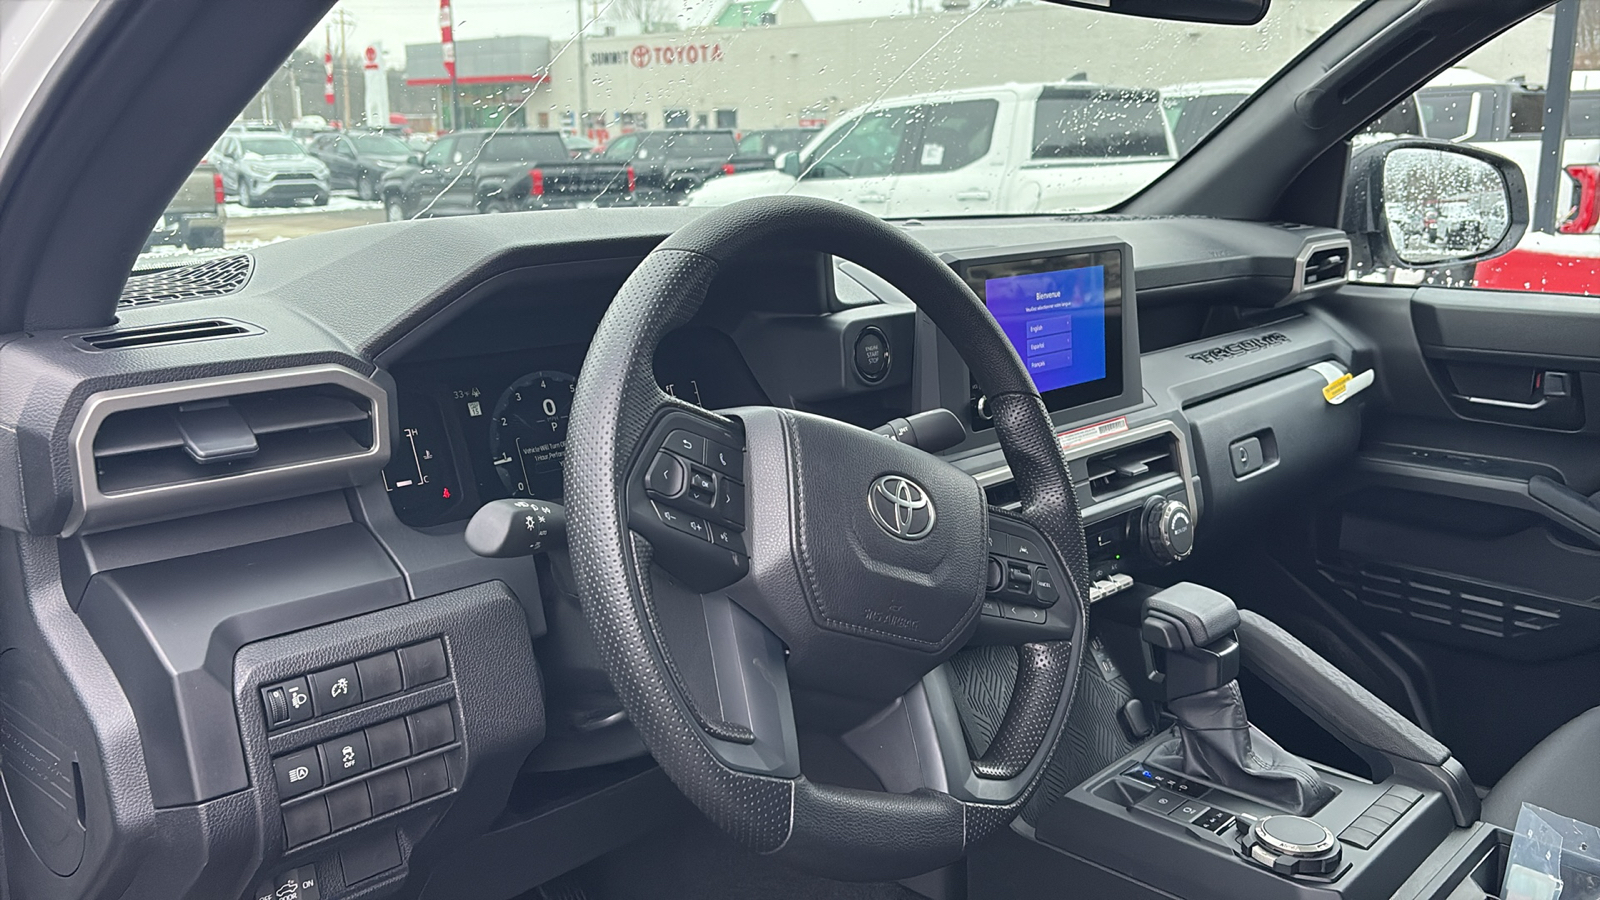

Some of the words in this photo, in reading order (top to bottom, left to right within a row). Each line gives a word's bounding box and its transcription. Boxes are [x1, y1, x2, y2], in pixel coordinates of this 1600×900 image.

[591, 50, 629, 66] SUMMIT
[653, 43, 723, 65] TOYOTA
[1035, 291, 1061, 301] Bienvenue
[1030, 324, 1043, 333] English
[1186, 331, 1292, 365] TACOMA
[866, 350, 879, 358] START
[868, 357, 879, 365] STOP
[540, 380, 547, 389] 4
[569, 384, 576, 393] 5
[515, 392, 522, 401] 3
[542, 398, 557, 416] 0
[501, 417, 508, 427] 2
[551, 422, 558, 432] P
[411, 428, 419, 436] H
[522, 446, 540, 455] Vehicle
[423, 475, 430, 484] C
[518, 482, 524, 491] 0
[1036, 580, 1052, 589] CANCEL
[884, 615, 919, 631] AIRBAG
[343, 759, 356, 769] OFF
[302, 879, 314, 889] ON
